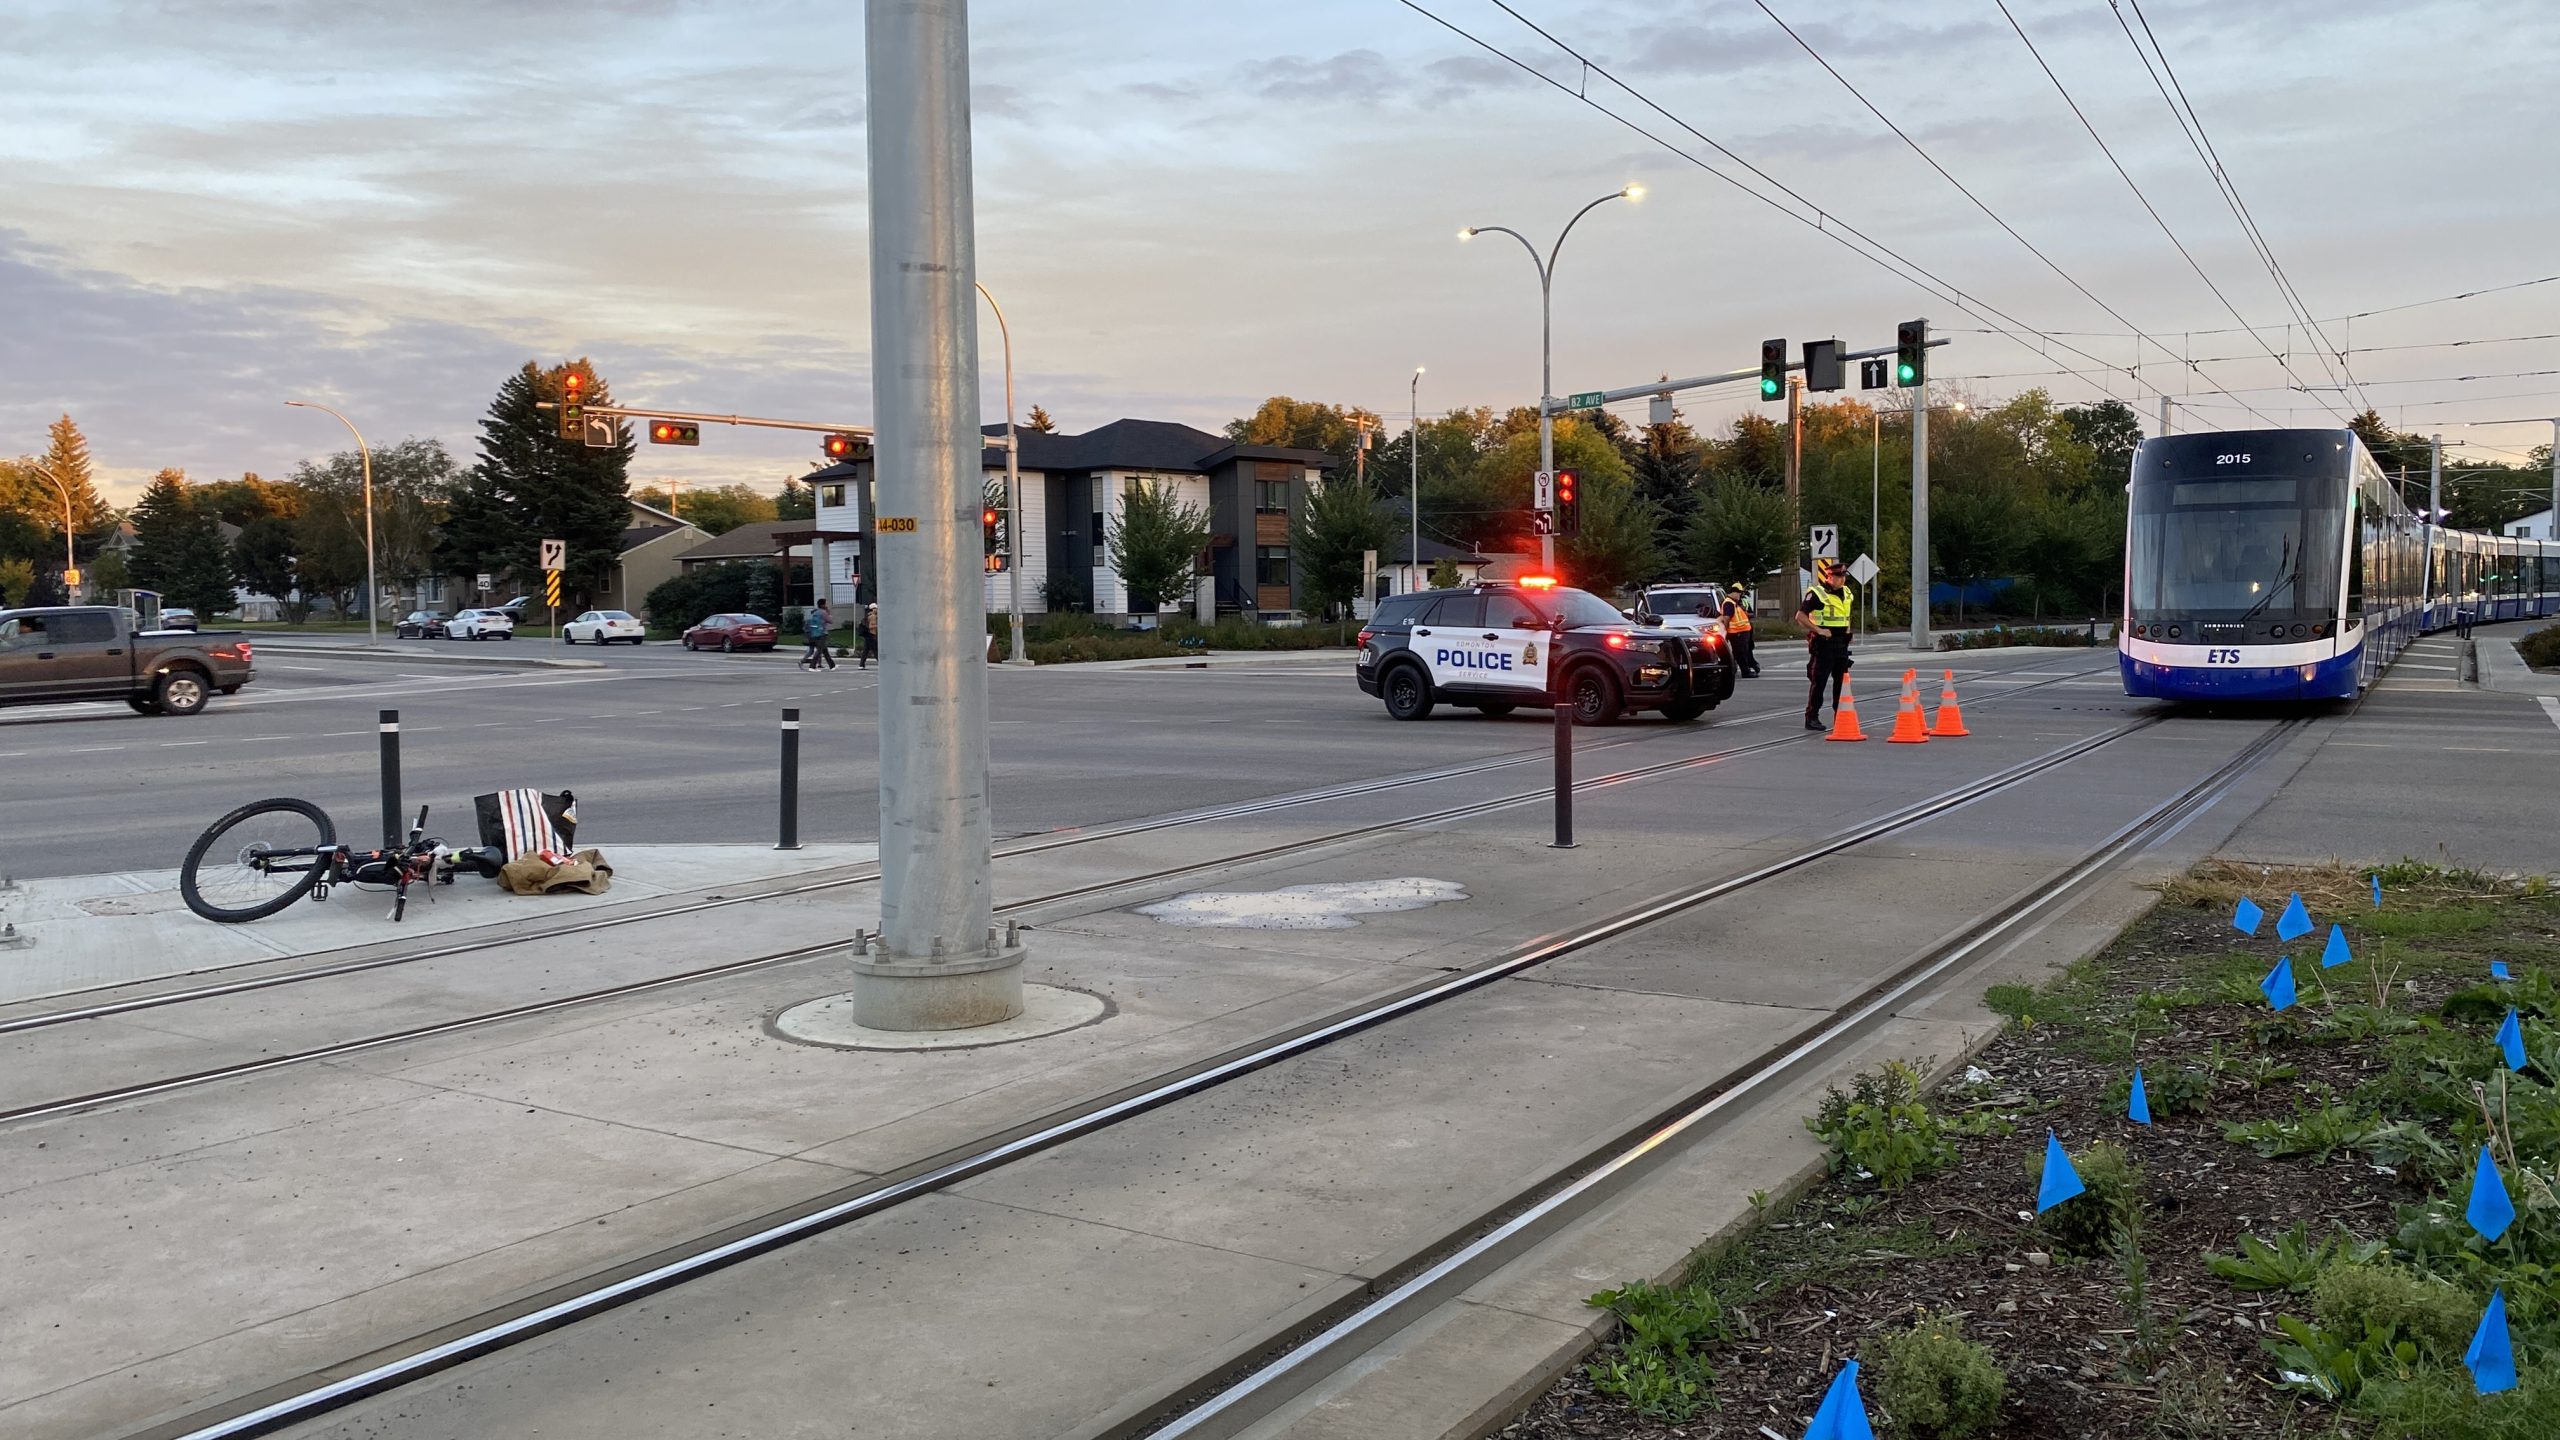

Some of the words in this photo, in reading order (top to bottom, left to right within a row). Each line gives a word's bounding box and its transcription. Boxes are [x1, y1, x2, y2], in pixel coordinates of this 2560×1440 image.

[1571, 397, 1581, 407] 82
[1586, 394, 1601, 406] AVE
[2216, 453, 2251, 465] 2015
[479, 580, 490, 588] 40
[1456, 641, 1495, 649] EDMONTON
[1437, 649, 1512, 671] POLICE
[2208, 649, 2240, 664] ETS
[1459, 671, 1488, 679] SERVICE
